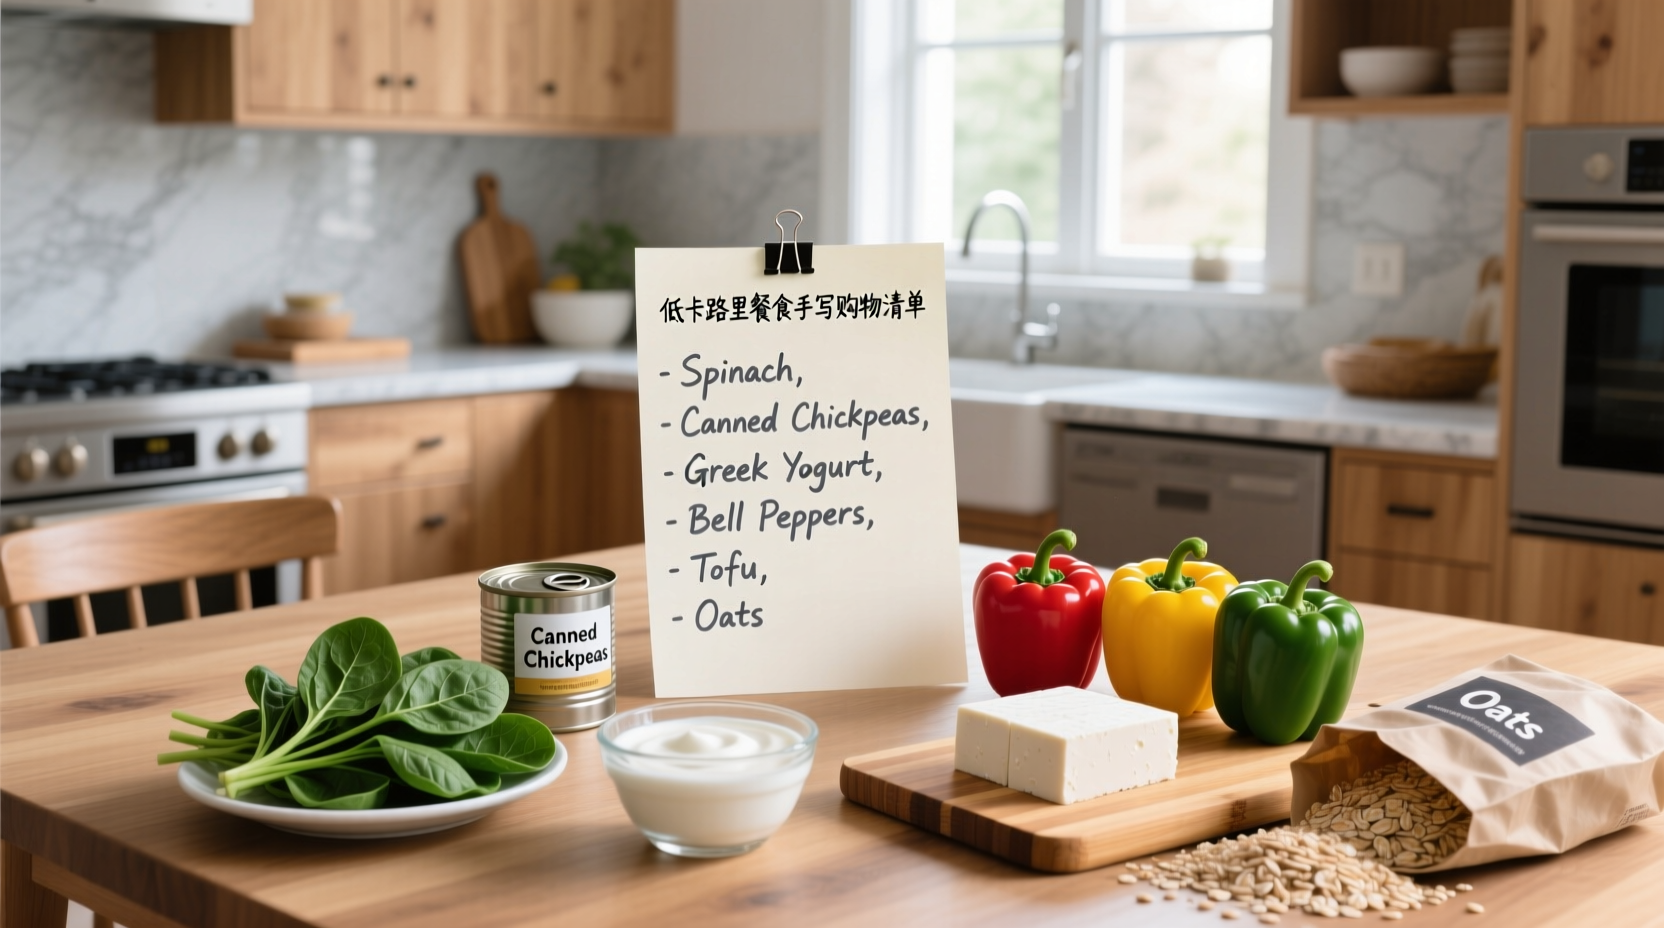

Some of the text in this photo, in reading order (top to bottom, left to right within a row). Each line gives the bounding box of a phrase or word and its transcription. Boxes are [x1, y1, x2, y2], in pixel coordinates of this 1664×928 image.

[659, 289, 926, 323] 低卡路里餐食手写购物清单
[680, 351, 803, 401] Spinach,
[680, 401, 779, 438] Canned
[791, 399, 929, 441] Chickpeas,
[684, 452, 769, 488] Greek
[782, 450, 882, 494] Yogurt,
[688, 500, 745, 535] Bell
[759, 498, 874, 542] Peppers,
[690, 549, 767, 588] Tofu,
[530, 621, 597, 645] Canned
[695, 598, 764, 632] Oats
[523, 647, 609, 672] Chickpeas
[1459, 689, 1544, 740] Oats
